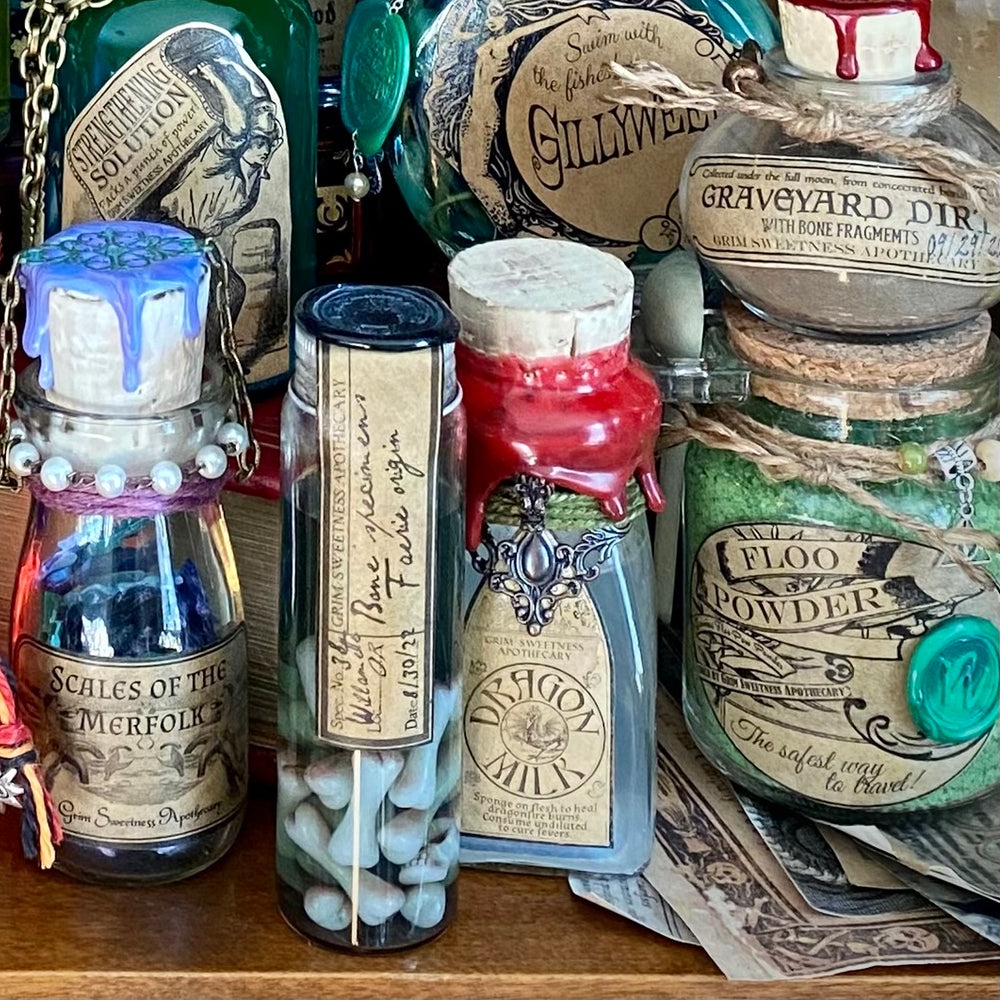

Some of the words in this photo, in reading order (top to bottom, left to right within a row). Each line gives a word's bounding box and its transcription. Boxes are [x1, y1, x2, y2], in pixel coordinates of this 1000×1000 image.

[565, 28, 620, 63] Swim
[625, 21, 664, 50] with
[533, 64, 561, 93] the
[72, 62, 171, 172] STRENGTHENING
[90, 83, 192, 191] SOLUTION
[163, 120, 210, 167] APOTHECARY
[528, 100, 718, 191] GILLYWEE
[737, 170, 762, 180] under
[765, 170, 781, 182] the
[784, 171, 801, 183] full
[842, 176, 868, 188] from
[701, 184, 893, 221] GRAVEYARD
[761, 217, 795, 234] WITH
[798, 220, 834, 237] BONE
[713, 235, 747, 248] GRIM
[751, 238, 856, 255] SWEETNESS
[331, 378, 348, 485] APOTHECARY
[382, 429, 425, 495] origin
[331, 488, 346, 585] SWEETNESS
[739, 545, 840, 571] FLOO
[331, 587, 344, 628] GRIM
[712, 584, 884, 625] POWDER
[485, 636, 515, 648] GRIM
[519, 638, 585, 651] SWEETNESS
[499, 647, 572, 661] APOTHECARY
[50, 665, 141, 701] SCALES
[150, 676, 182, 699] OF
[187, 659, 227, 693] THE
[784, 685, 846, 697] APOTHECARY
[469, 669, 600, 736] DRAGON
[78, 704, 207, 736] MERFOLK
[730, 717, 774, 755] The
[779, 743, 836, 774] safest
[841, 757, 886, 779] way
[482, 751, 587, 796] MILK
[825, 772, 847, 793] to
[854, 769, 927, 795] travel!
[58, 799, 91, 824] Grim
[94, 806, 156, 829] Sweetness
[158, 801, 223, 829] Apothecary
[473, 791, 513, 809] Sponge
[515, 802, 529, 810] on
[531, 803, 558, 813] flesh
[560, 804, 572, 813] to
[574, 802, 598, 813] heal
[487, 805, 546, 821] dragonfire
[482, 812, 531, 827] Consume
[534, 820, 588, 831] undiluted
[498, 824, 510, 833] to
[511, 826, 535, 836] cure
